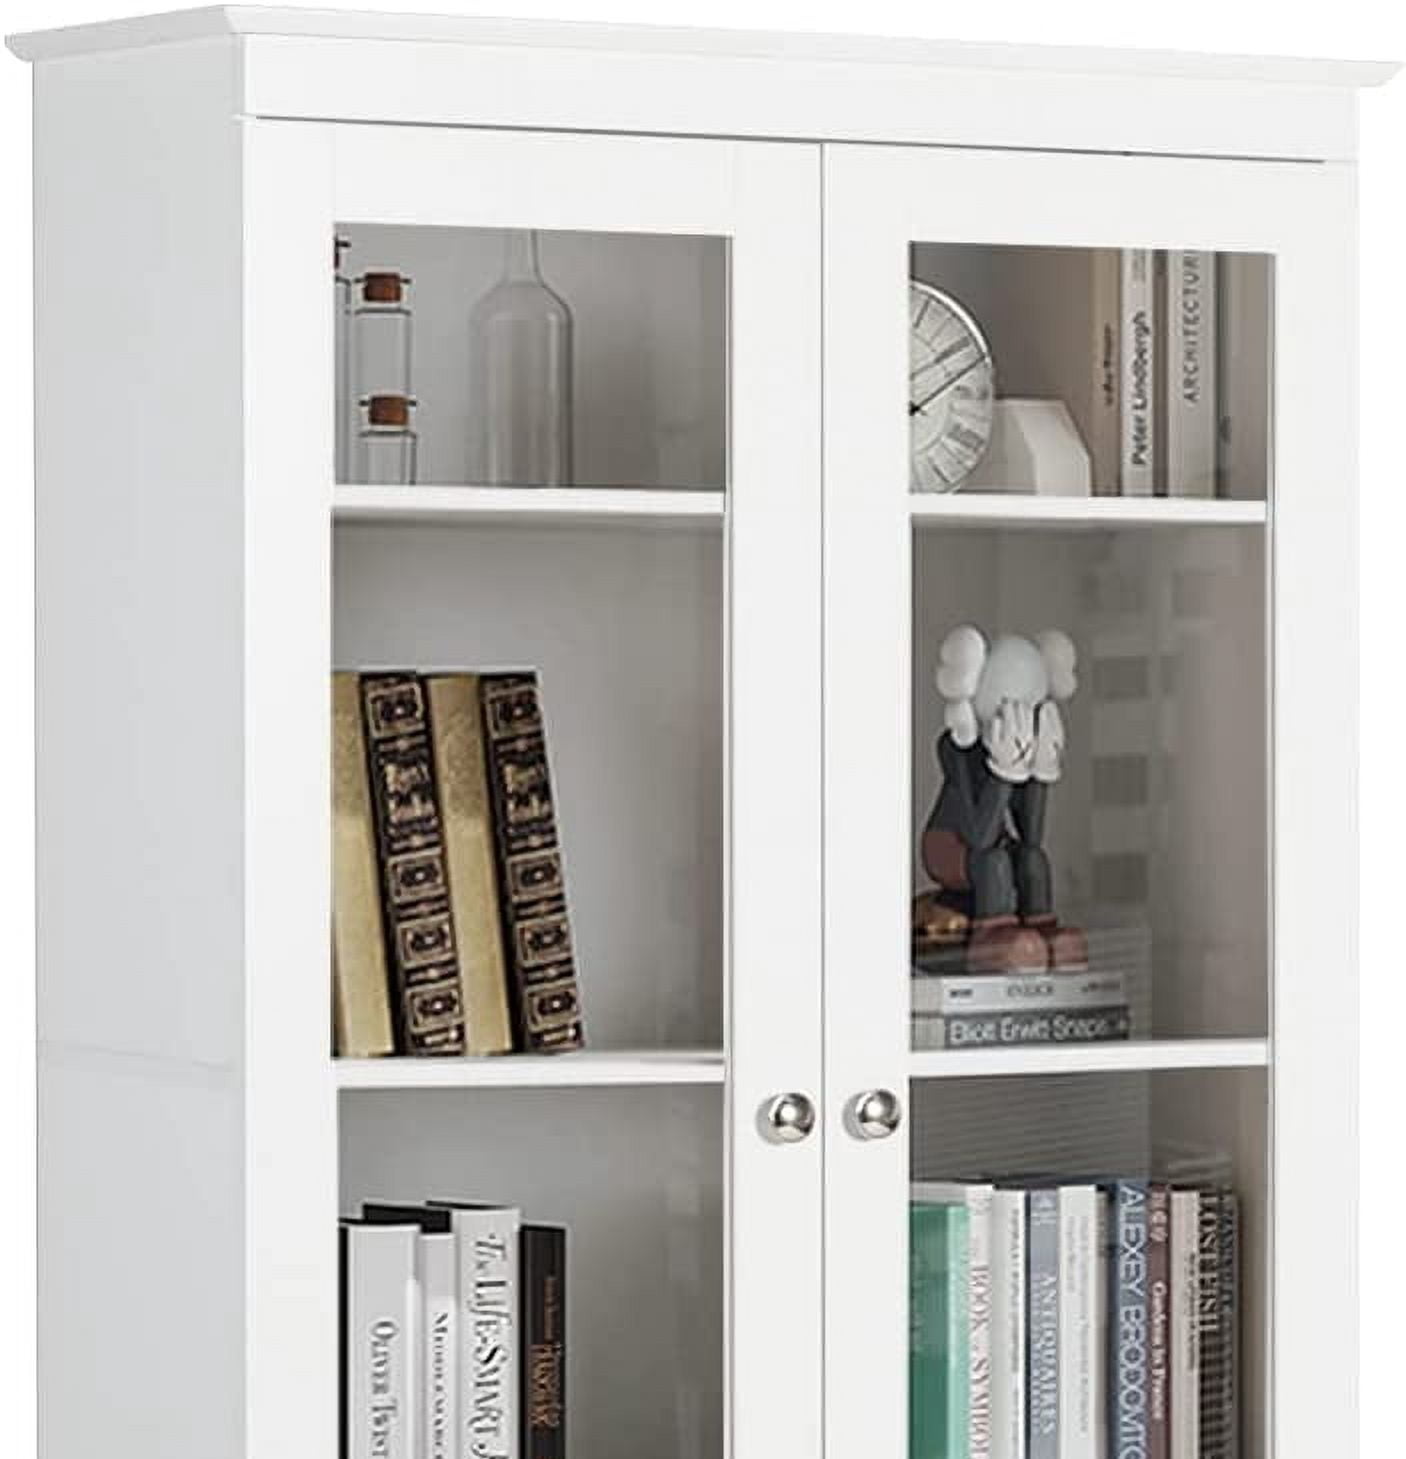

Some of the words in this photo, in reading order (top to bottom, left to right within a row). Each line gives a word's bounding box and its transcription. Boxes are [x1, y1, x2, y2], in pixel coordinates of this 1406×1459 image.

[1130, 310, 1150, 411] Lindbergh
[1131, 415, 1149, 466] Peter
[1119, 1186, 1146, 1298] ALEXEY
[371, 1319, 400, 1396] OLIVER
[1040, 1272, 1058, 1435] ANTIQUAIRES
[370, 1399, 397, 1459] TWIST
